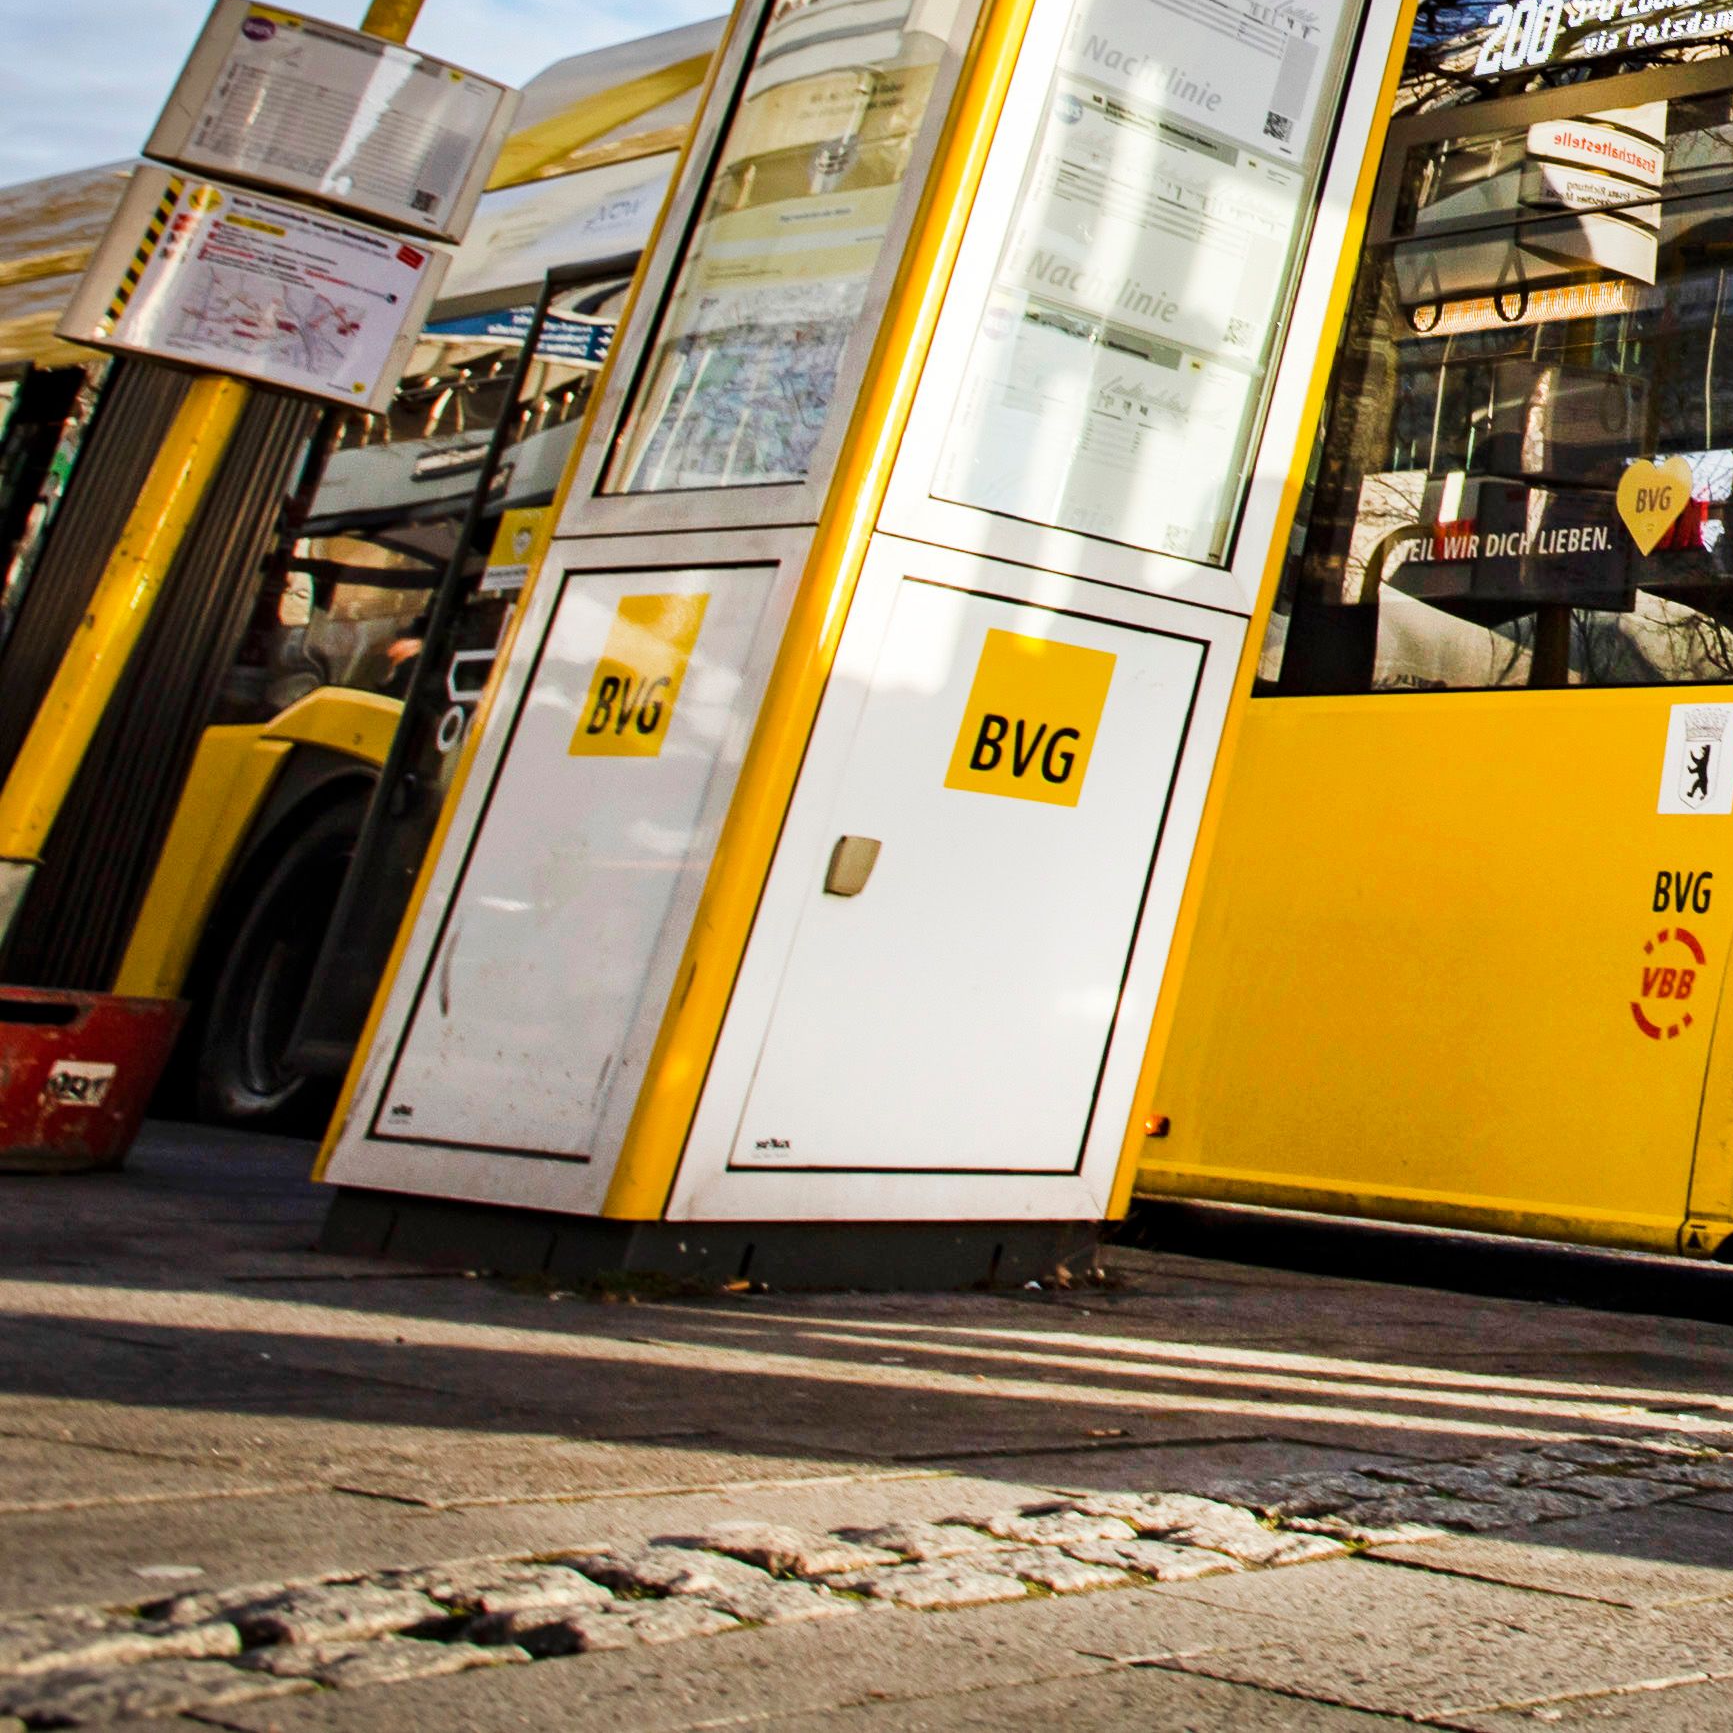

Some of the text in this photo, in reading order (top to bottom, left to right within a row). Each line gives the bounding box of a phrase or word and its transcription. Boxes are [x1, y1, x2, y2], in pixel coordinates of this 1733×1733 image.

[1584, 31, 1619, 54] via
[1082, 35, 1222, 111] Naclinie
[1028, 249, 1178, 323] Naclinie
[1635, 486, 1672, 514] BVG
[1444, 536, 1479, 560] WIR
[1485, 531, 1531, 558] DICH
[1538, 526, 1612, 553] LIEBEN.
[587, 675, 670, 735] BVG
[970, 714, 1080, 784] BVG
[1652, 871, 1713, 914] BVG
[1640, 965, 1697, 1001] VBB
